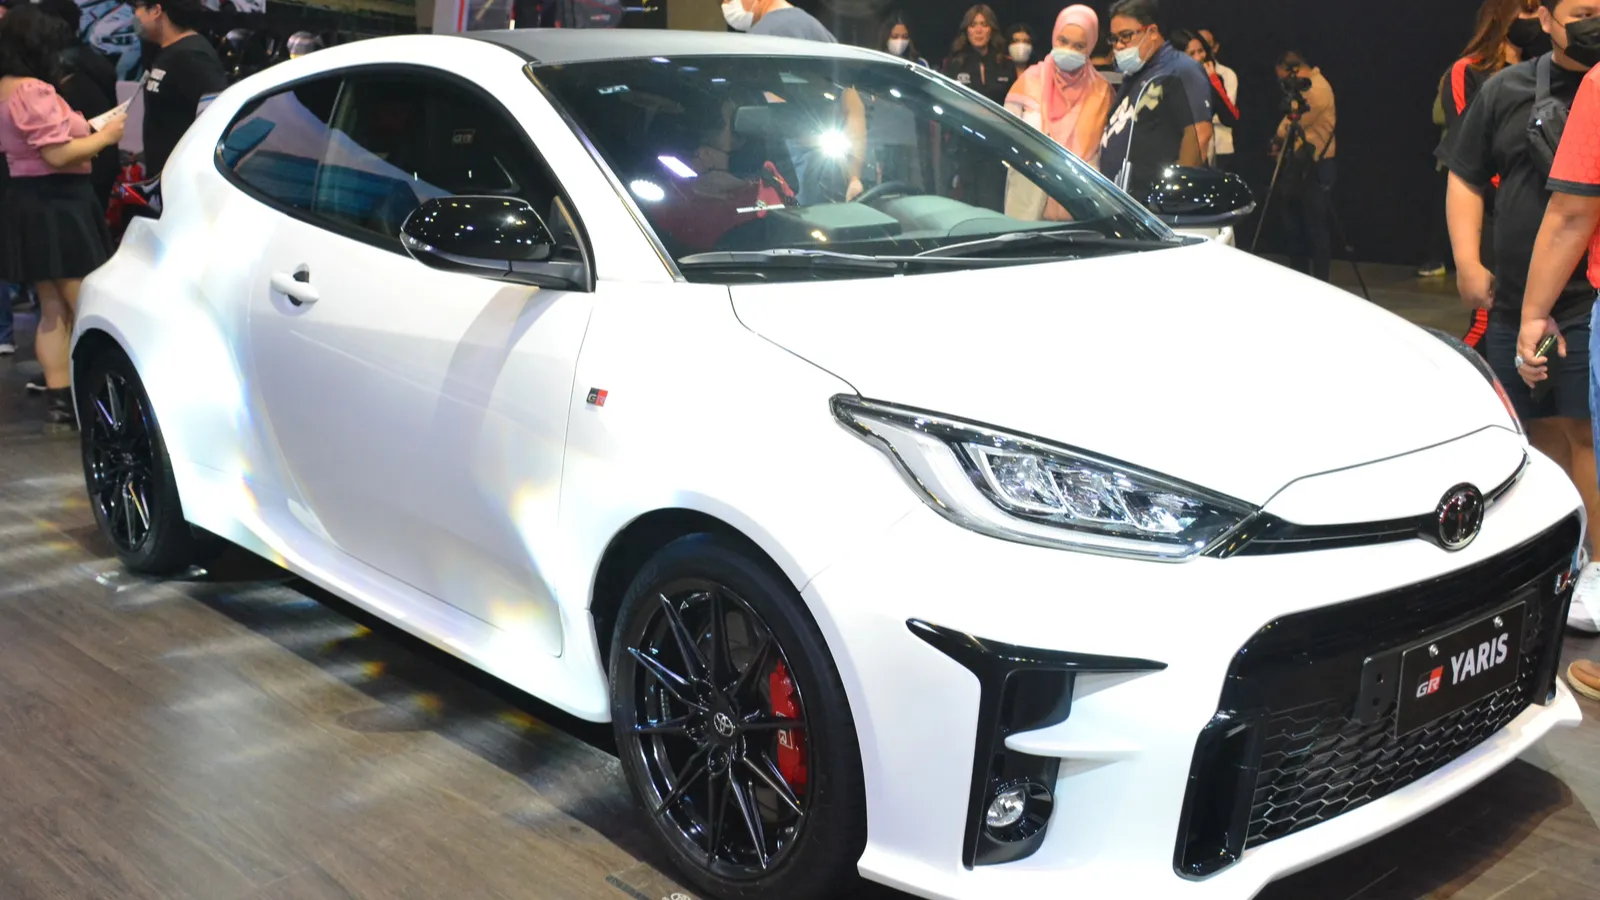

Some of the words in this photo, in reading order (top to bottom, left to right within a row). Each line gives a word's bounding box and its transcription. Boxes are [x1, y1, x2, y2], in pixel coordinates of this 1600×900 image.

[587, 393, 606, 406] GR
[1416, 675, 1442, 698] GR
[1451, 632, 1509, 685] YARIS
